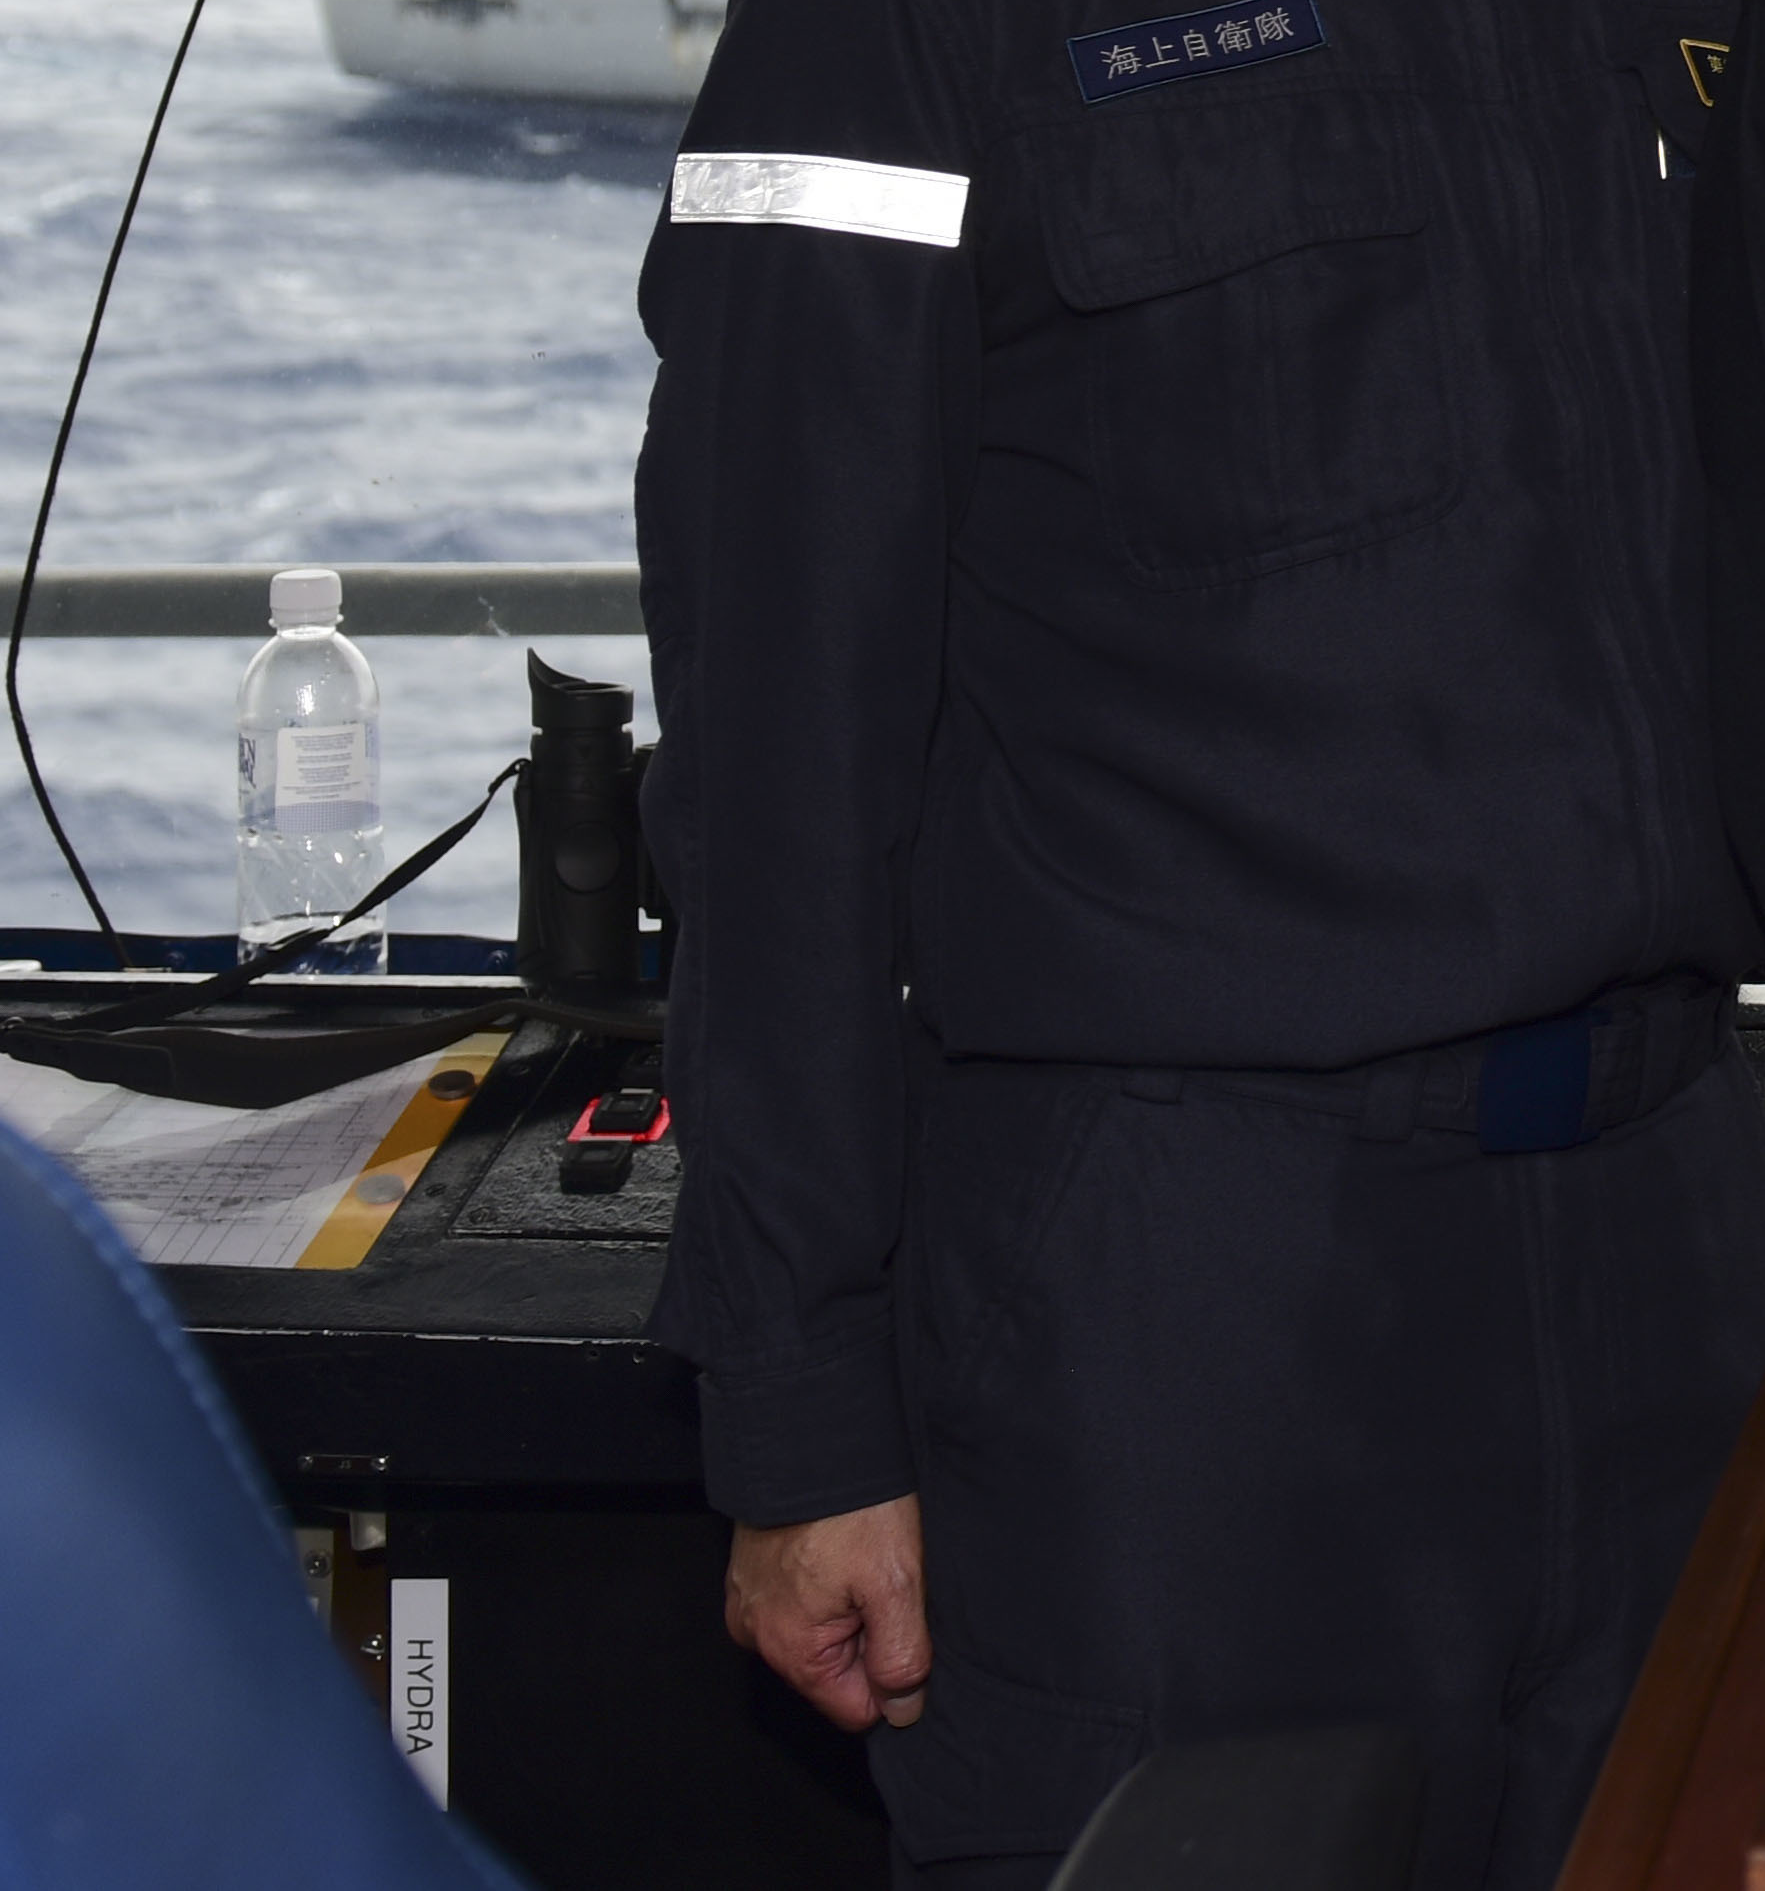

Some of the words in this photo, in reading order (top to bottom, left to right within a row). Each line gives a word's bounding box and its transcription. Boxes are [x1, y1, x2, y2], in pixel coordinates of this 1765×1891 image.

[1099, 6, 1296, 80] 海上自衛隊
[406, 1638, 434, 1756] HYDRA
